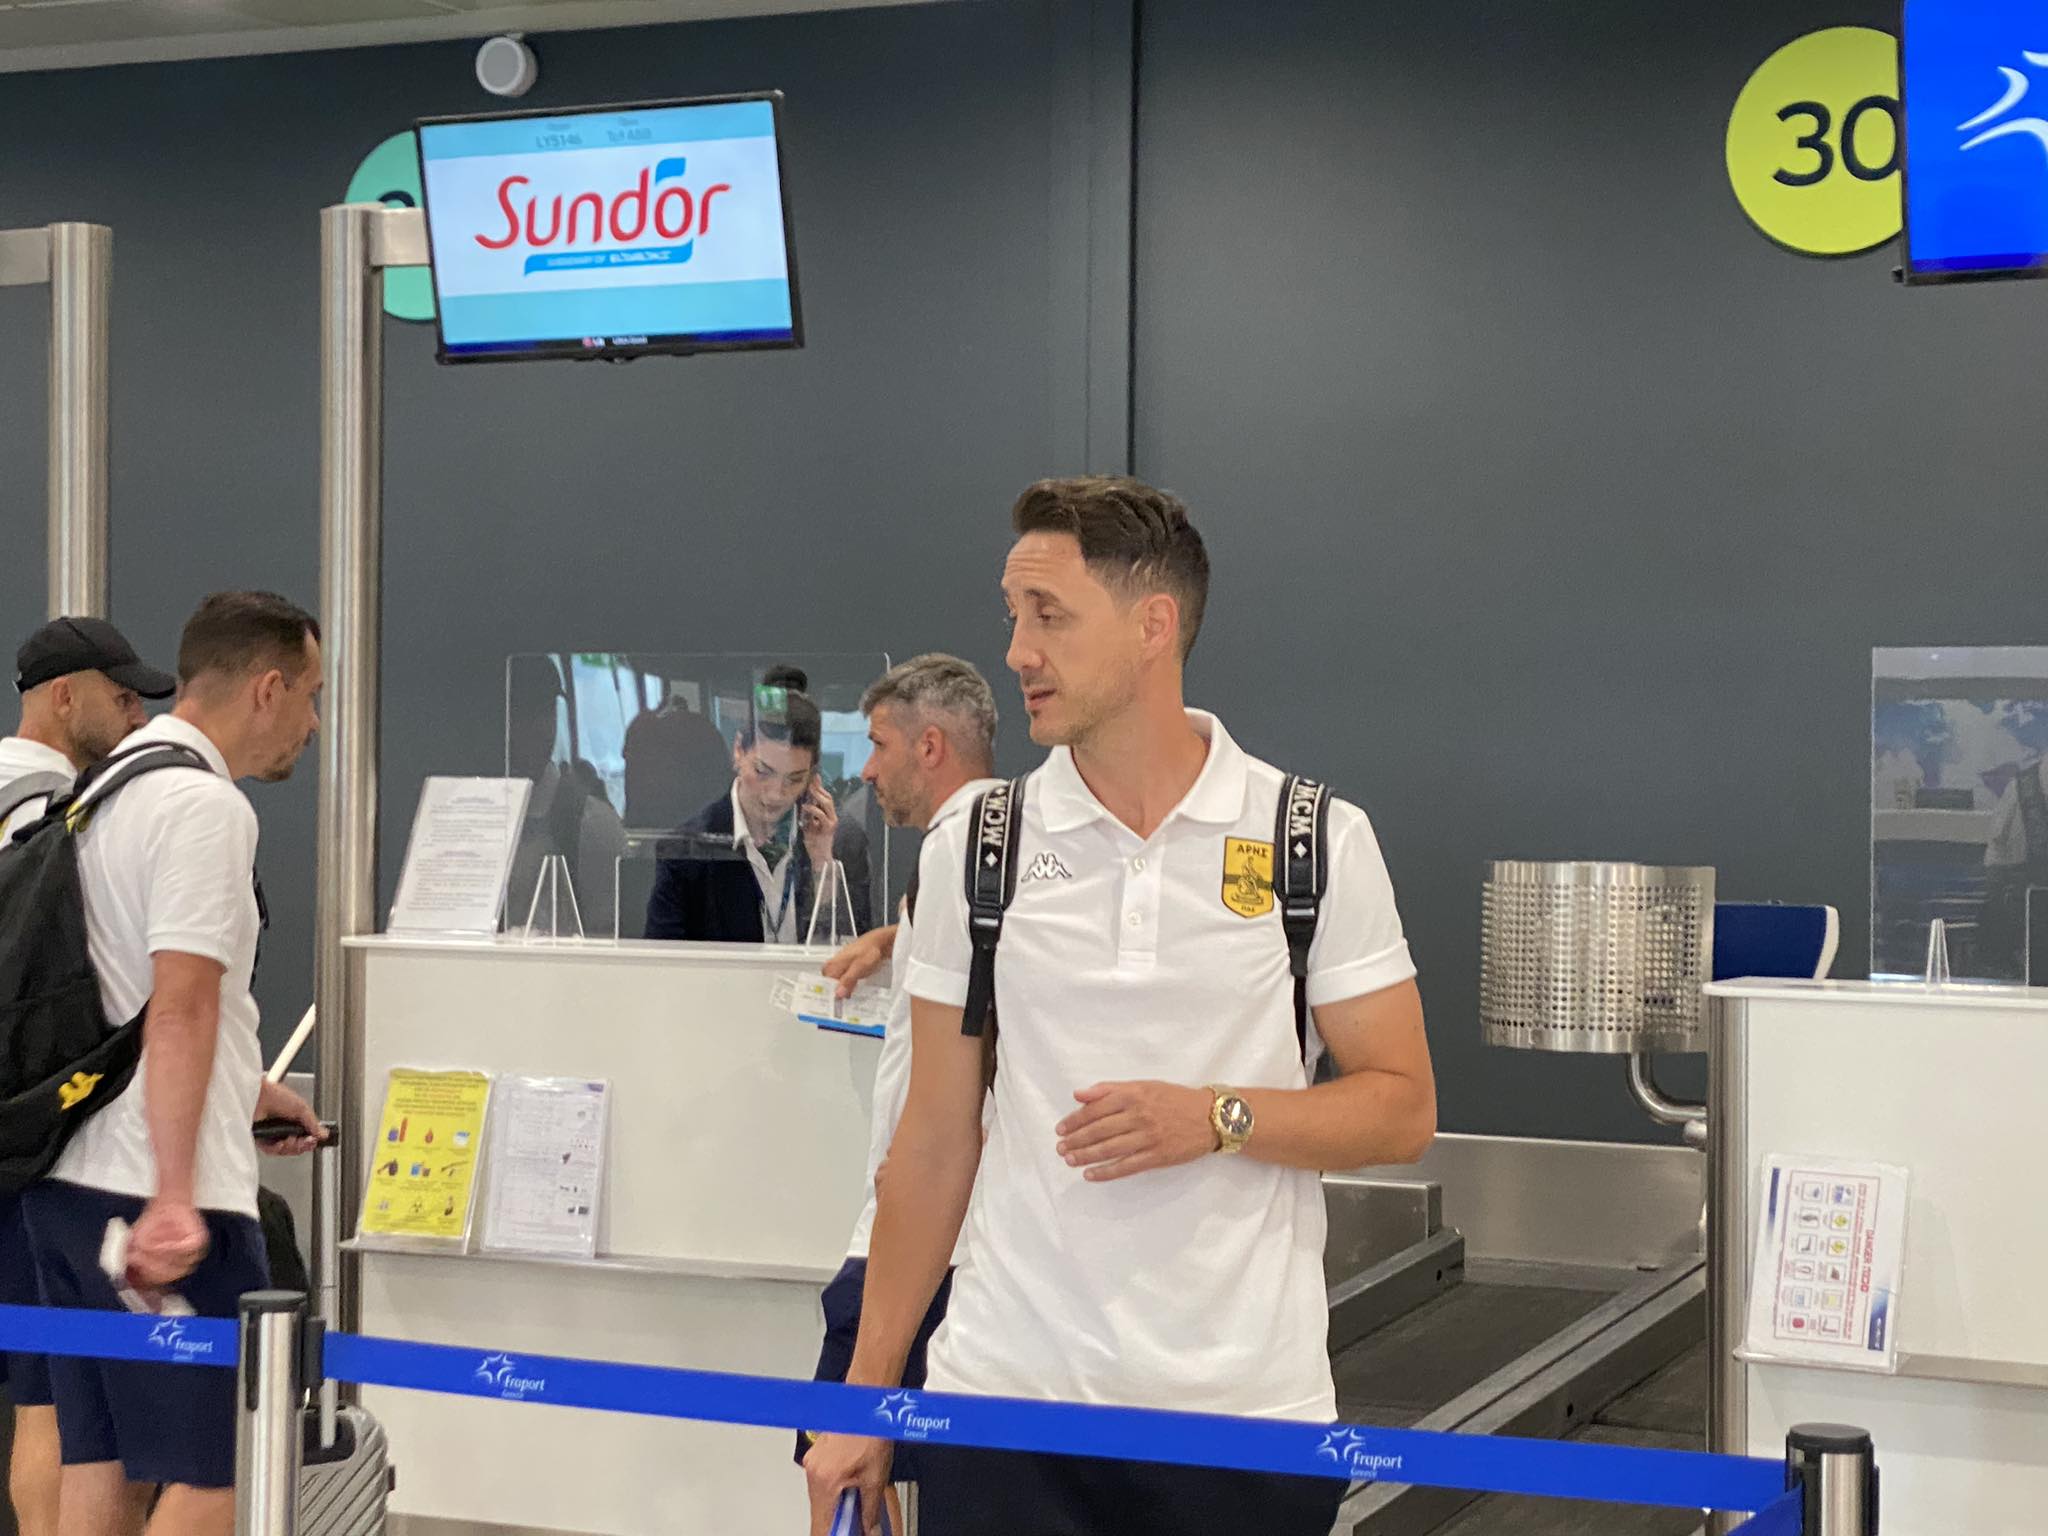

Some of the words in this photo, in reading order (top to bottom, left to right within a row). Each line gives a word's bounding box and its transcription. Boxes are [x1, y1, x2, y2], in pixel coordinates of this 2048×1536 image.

[1773, 95, 1900, 187] 30
[474, 166, 731, 250] Sundor
[504, 1375, 545, 1392] Fraport
[906, 1413, 951, 1431] Fraport
[1353, 1450, 1402, 1470] Fraport
